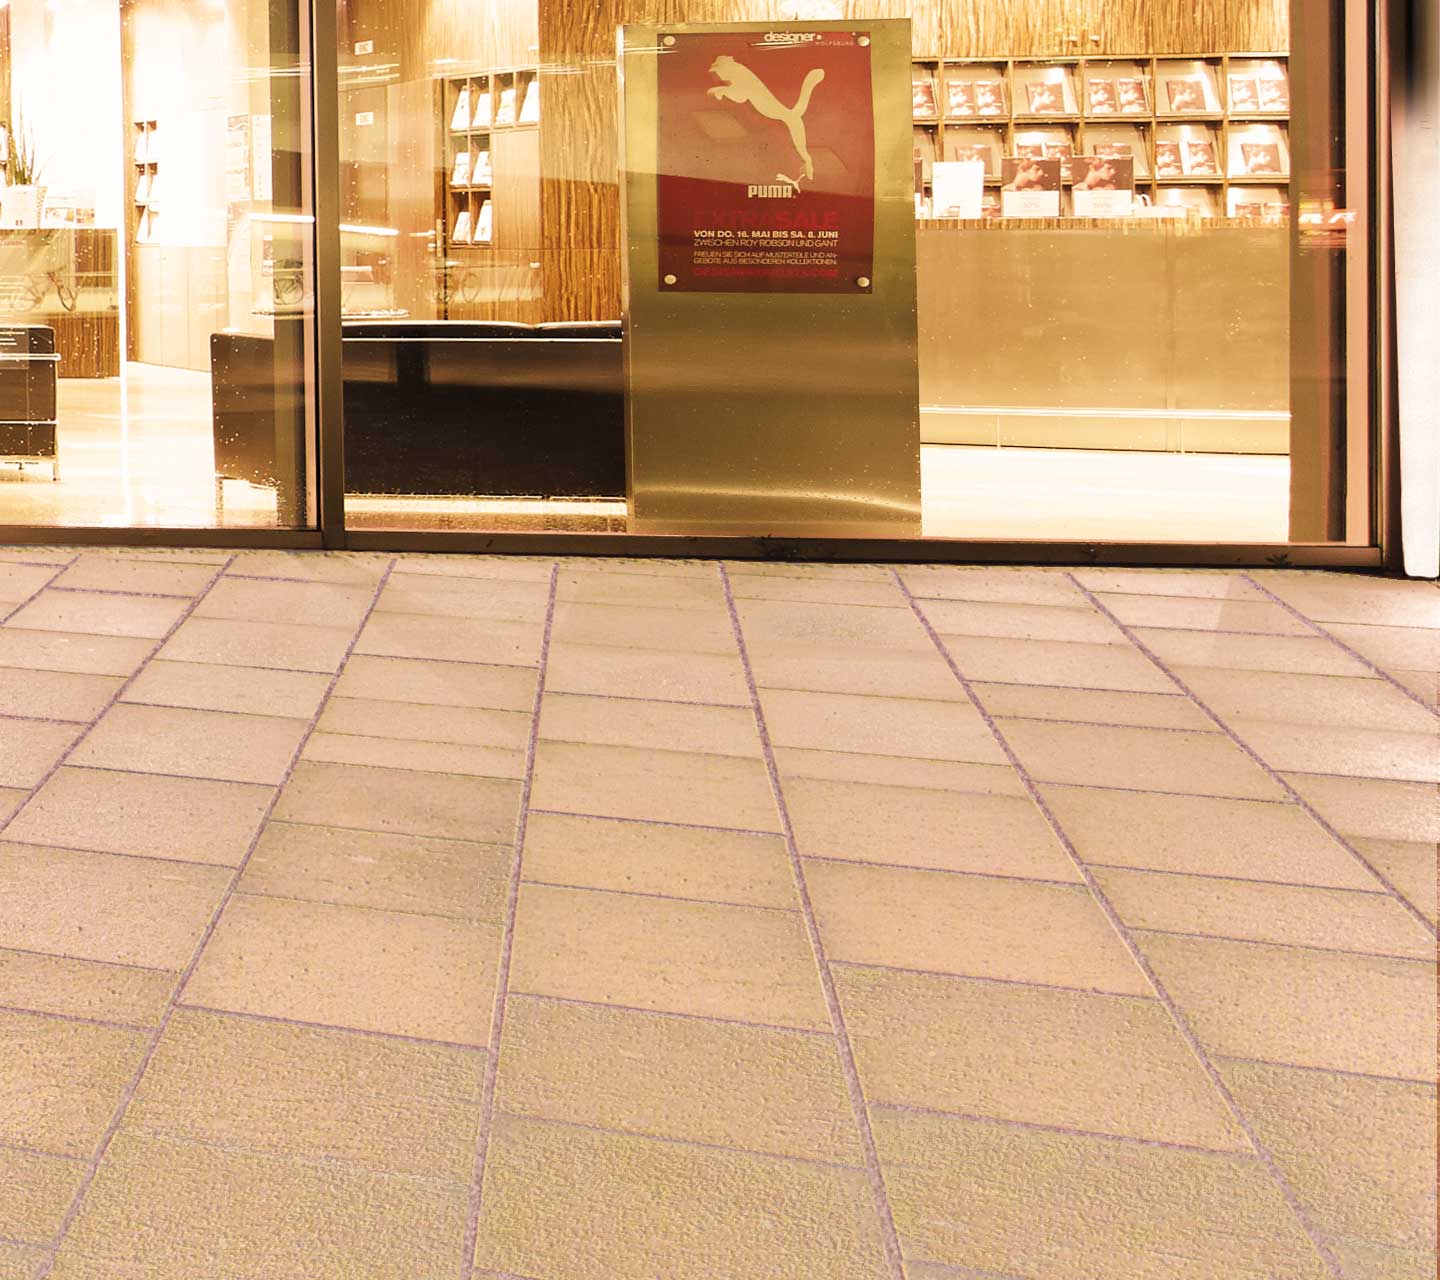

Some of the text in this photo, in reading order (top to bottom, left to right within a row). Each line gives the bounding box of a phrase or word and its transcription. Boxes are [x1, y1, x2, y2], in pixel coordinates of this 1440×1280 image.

[764, 30, 816, 43] designer
[747, 184, 793, 199] PUMA
[693, 230, 715, 238] VON
[717, 230, 734, 238] DO.
[751, 230, 770, 238] MAI
[772, 230, 789, 238] BIS
[790, 230, 806, 238] SA.
[817, 230, 839, 238] JUNI
[693, 239, 839, 247] ZWISCHEN ROY ROBSON UND GANT
